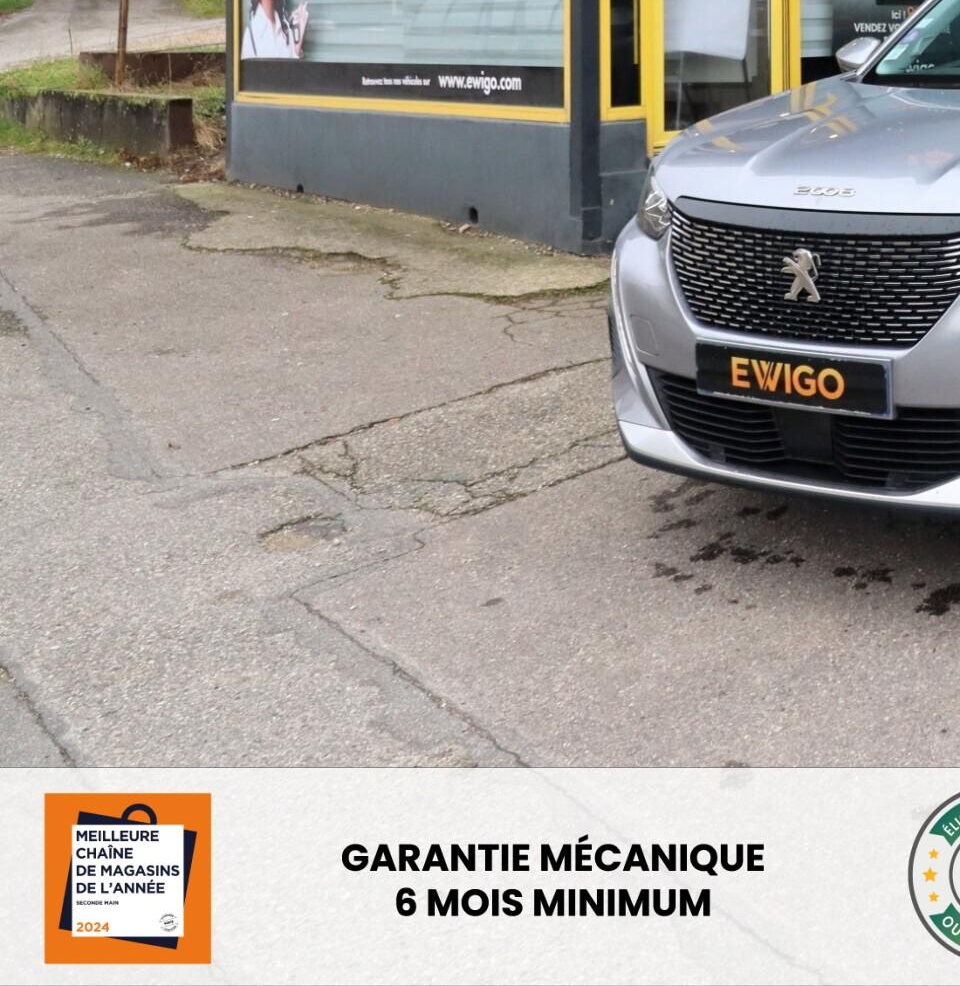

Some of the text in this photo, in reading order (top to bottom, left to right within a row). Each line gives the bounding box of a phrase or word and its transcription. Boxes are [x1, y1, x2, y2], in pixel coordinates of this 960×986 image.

[891, 9, 902, 20] Ici
[853, 22, 887, 33] VENDEZ
[438, 70, 522, 95] www.ewigo.com
[793, 186, 856, 197] 2008
[731, 356, 845, 400] EWIGO
